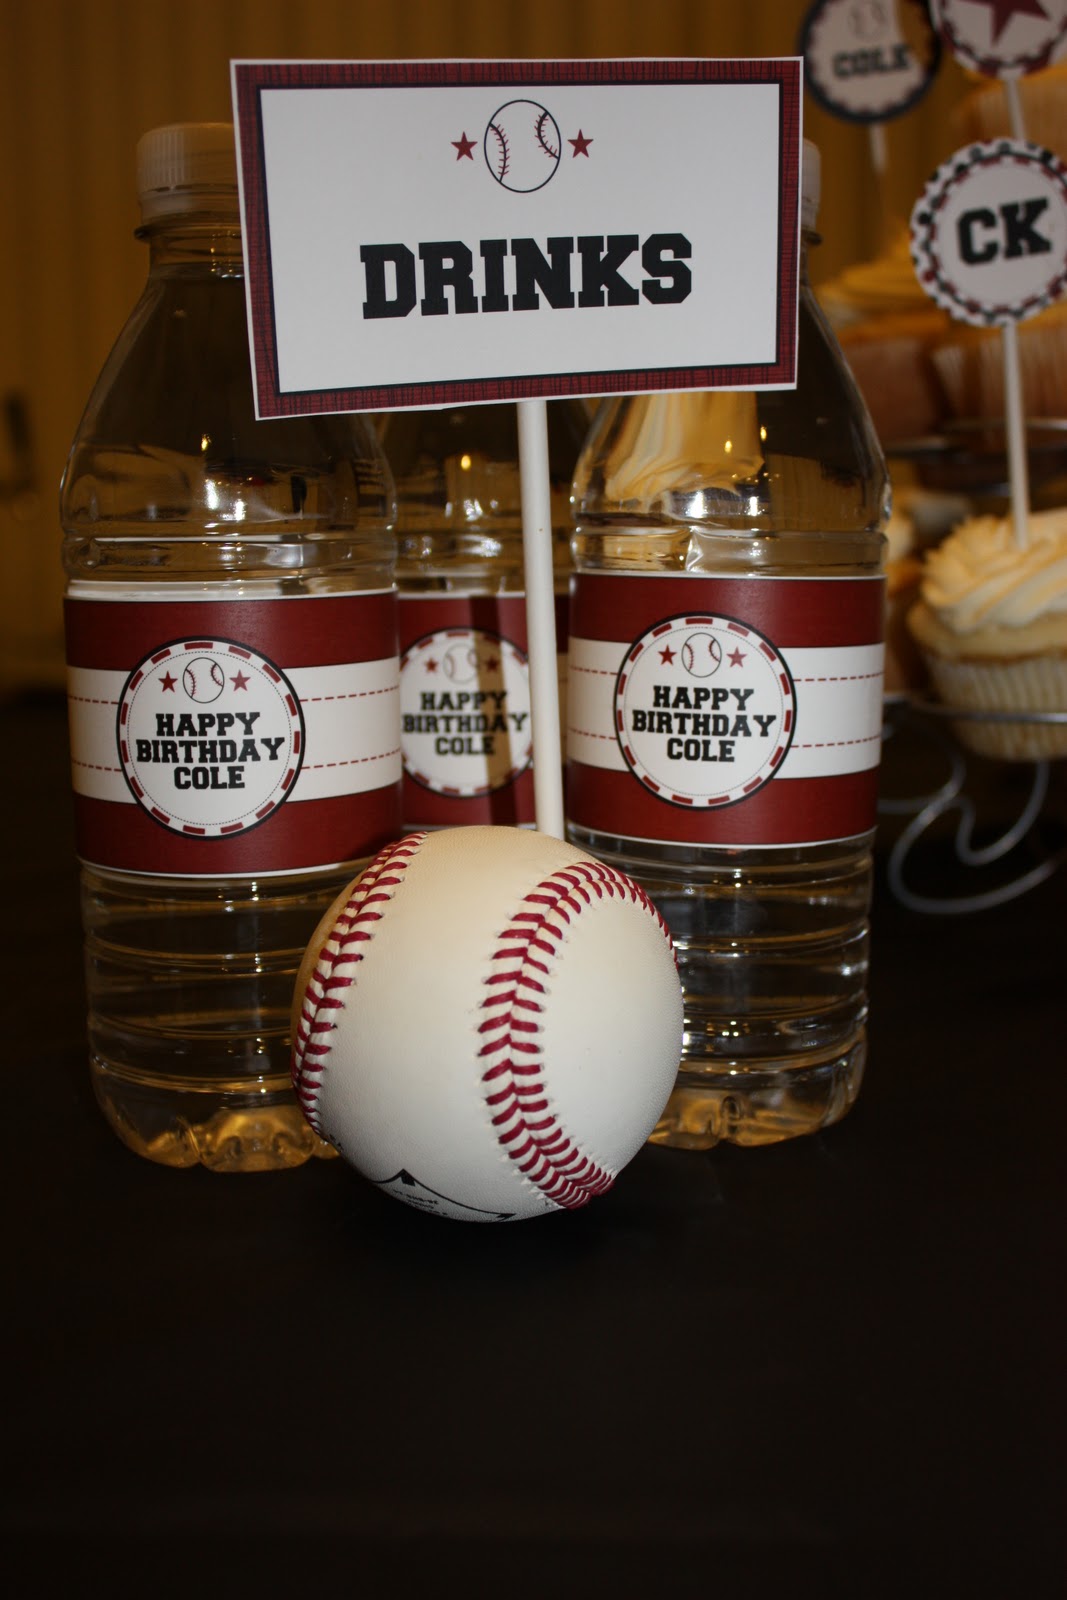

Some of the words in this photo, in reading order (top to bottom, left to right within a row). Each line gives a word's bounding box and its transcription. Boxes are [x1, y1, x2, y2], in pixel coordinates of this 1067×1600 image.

[833, 44, 910, 78] COLE
[956, 197, 1053, 266] CK
[359, 232, 693, 320] DRINKS
[420, 691, 507, 711] HAPPY
[652, 685, 755, 711] HAPPY
[155, 711, 261, 737] HAPPY
[402, 713, 528, 733] BIRTHDAY
[632, 709, 777, 737] BIRTHDAY
[135, 737, 286, 764] BIRTHDAY
[435, 737, 495, 755] COLE
[666, 737, 736, 763] COLE
[173, 765, 246, 790] COLE
